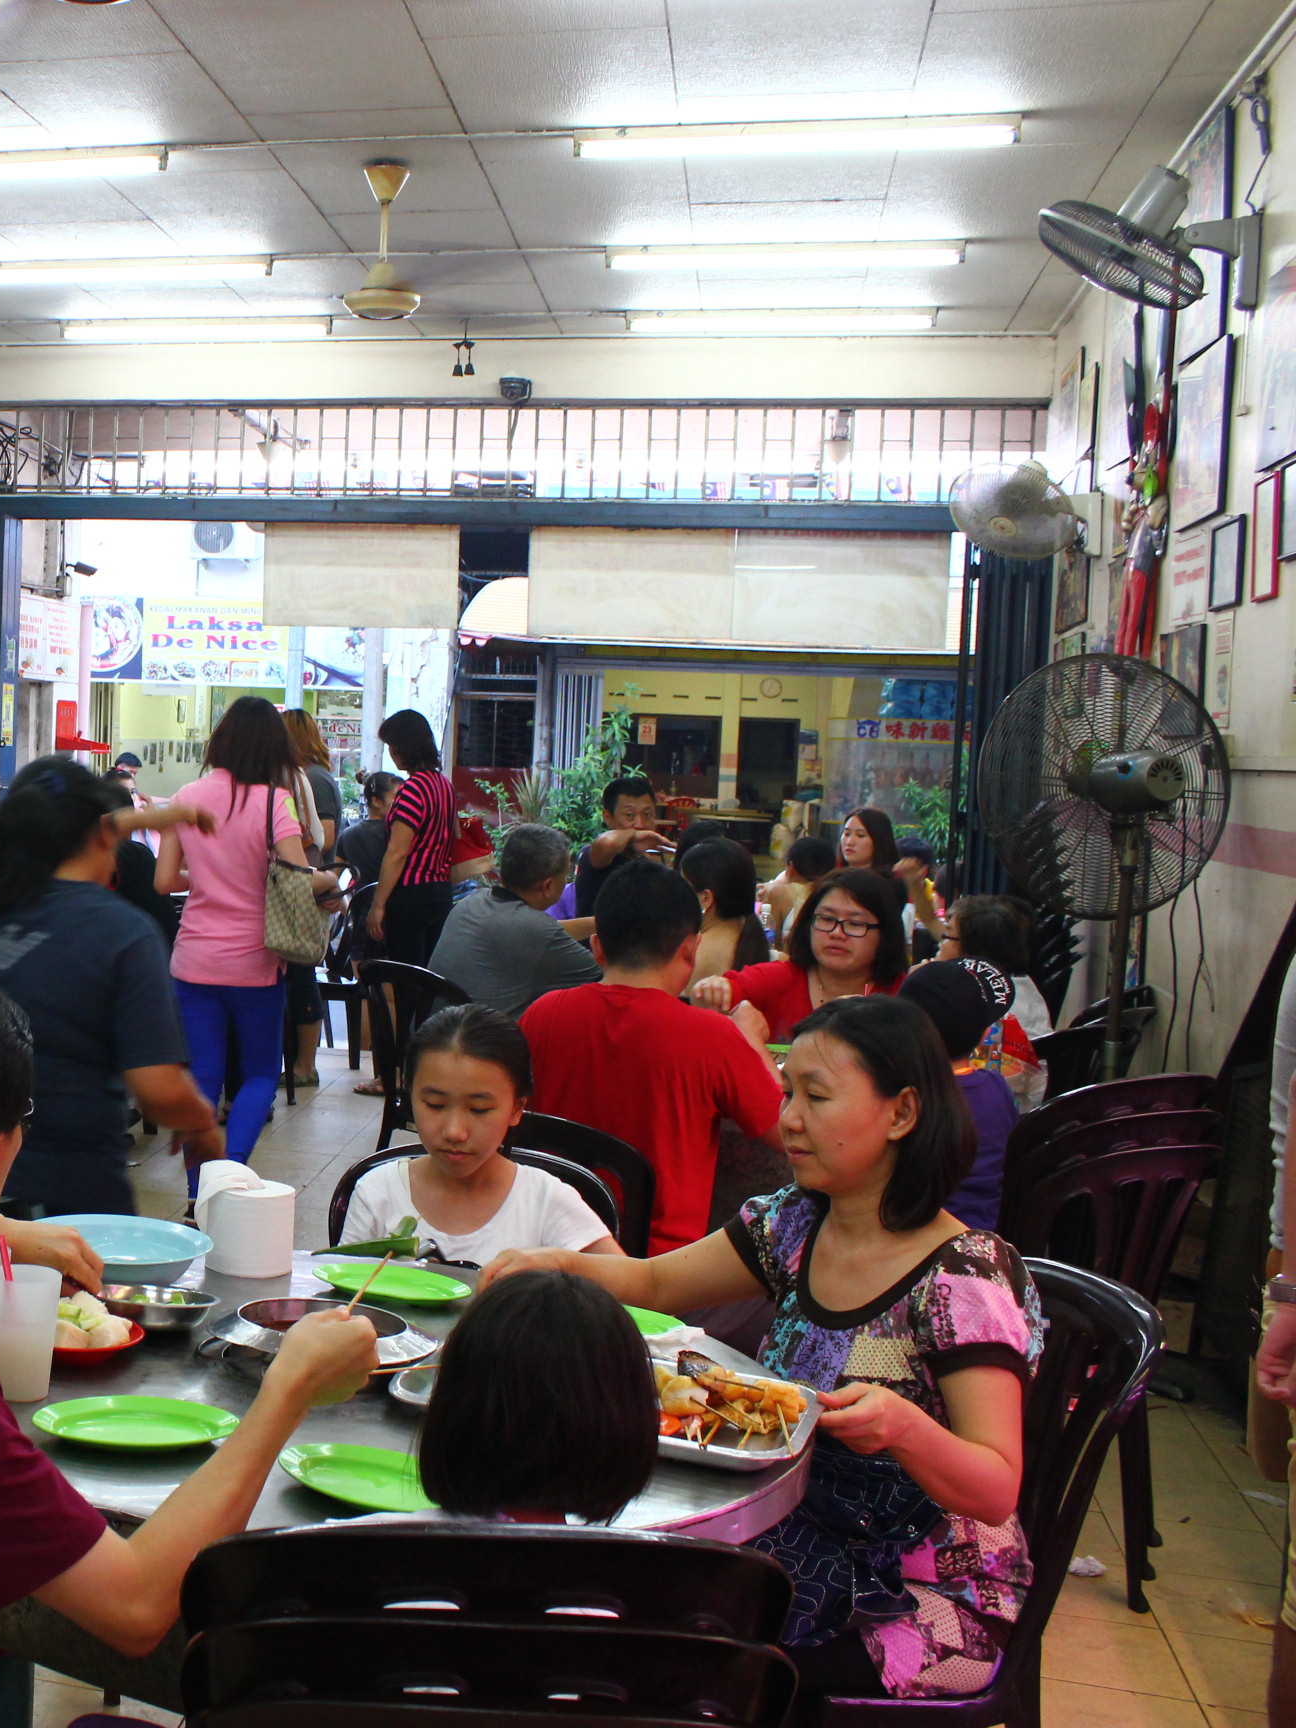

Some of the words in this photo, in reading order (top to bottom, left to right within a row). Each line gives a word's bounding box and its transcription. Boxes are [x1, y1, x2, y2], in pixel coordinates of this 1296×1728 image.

[176, 606, 218, 614] MAKANAN
[221, 607, 238, 615] DAN
[166, 615, 264, 631] Laksa
[151, 633, 193, 649] De
[206, 635, 278, 650] Nice
